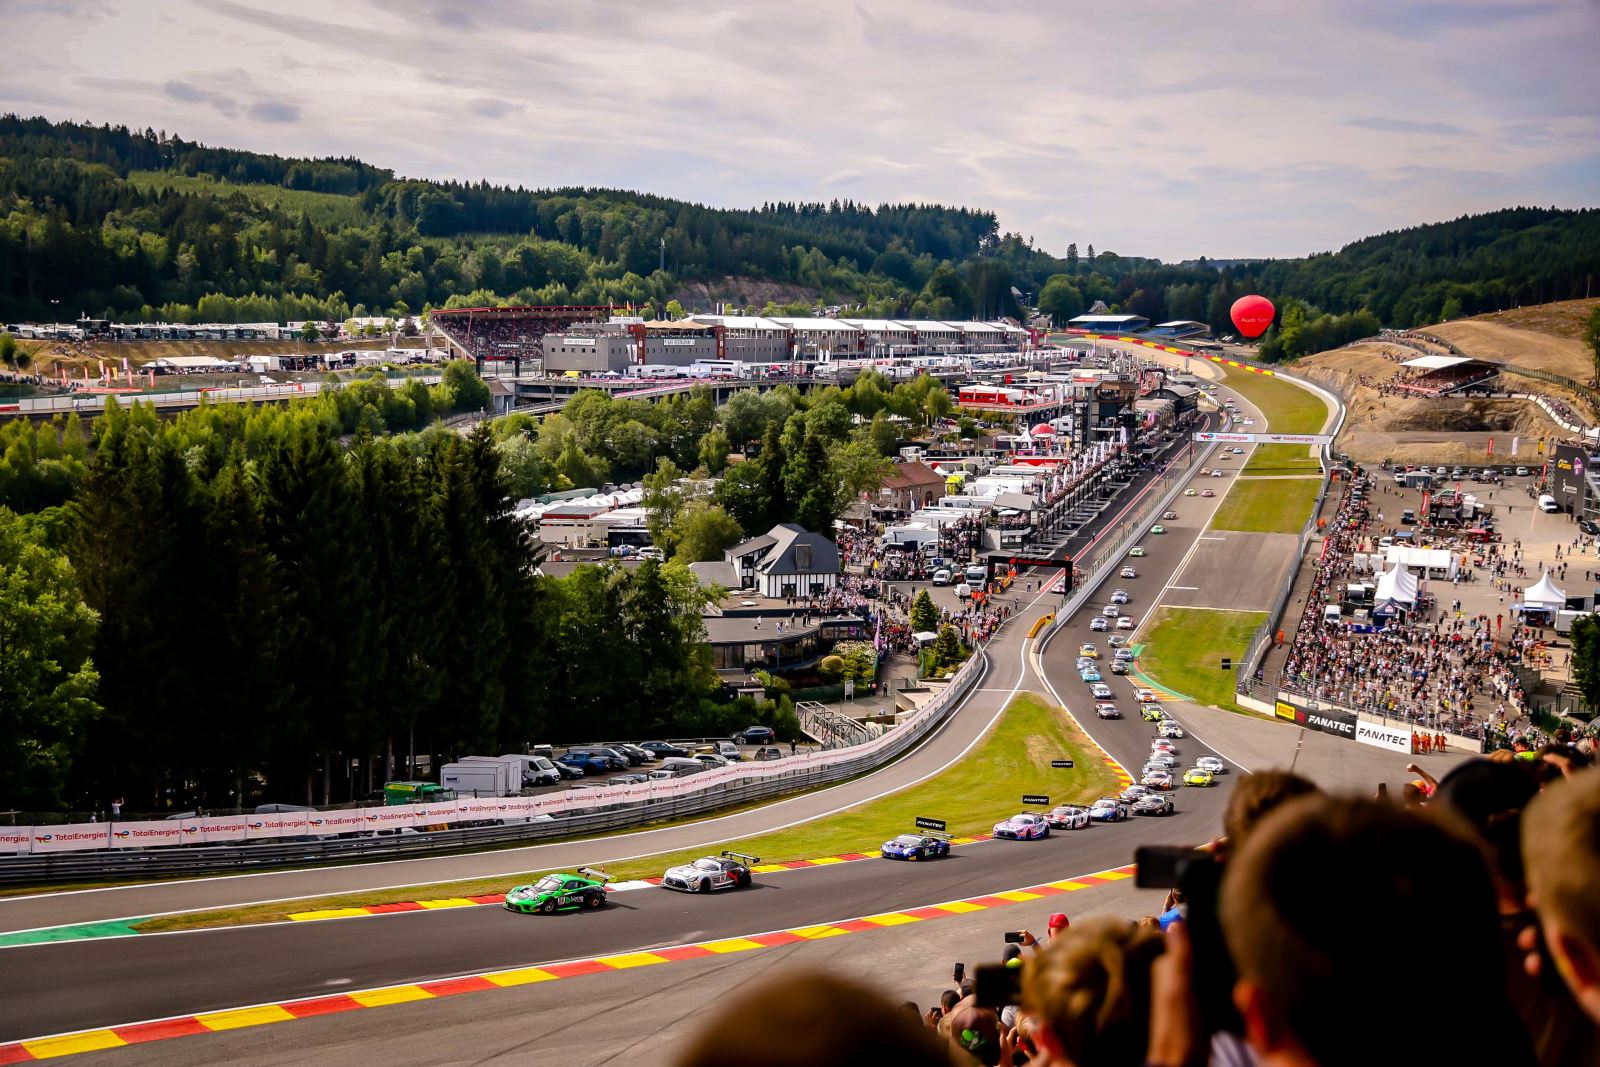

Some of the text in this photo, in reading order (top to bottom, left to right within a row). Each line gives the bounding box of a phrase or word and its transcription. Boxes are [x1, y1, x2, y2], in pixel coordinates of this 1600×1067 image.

[1308, 715, 1354, 732] FANATEC
[1358, 728, 1406, 745] FANATEC
[325, 816, 364, 825] TotalEnergies
[379, 811, 414, 821] TotalEnergies
[200, 823, 245, 834] TotalEnergies
[264, 819, 307, 829] TotalEnergies
[916, 820, 945, 829] FANATEC
[55, 831, 108, 841] TotalEnergies
[132, 828, 180, 837] TotalEnergies
